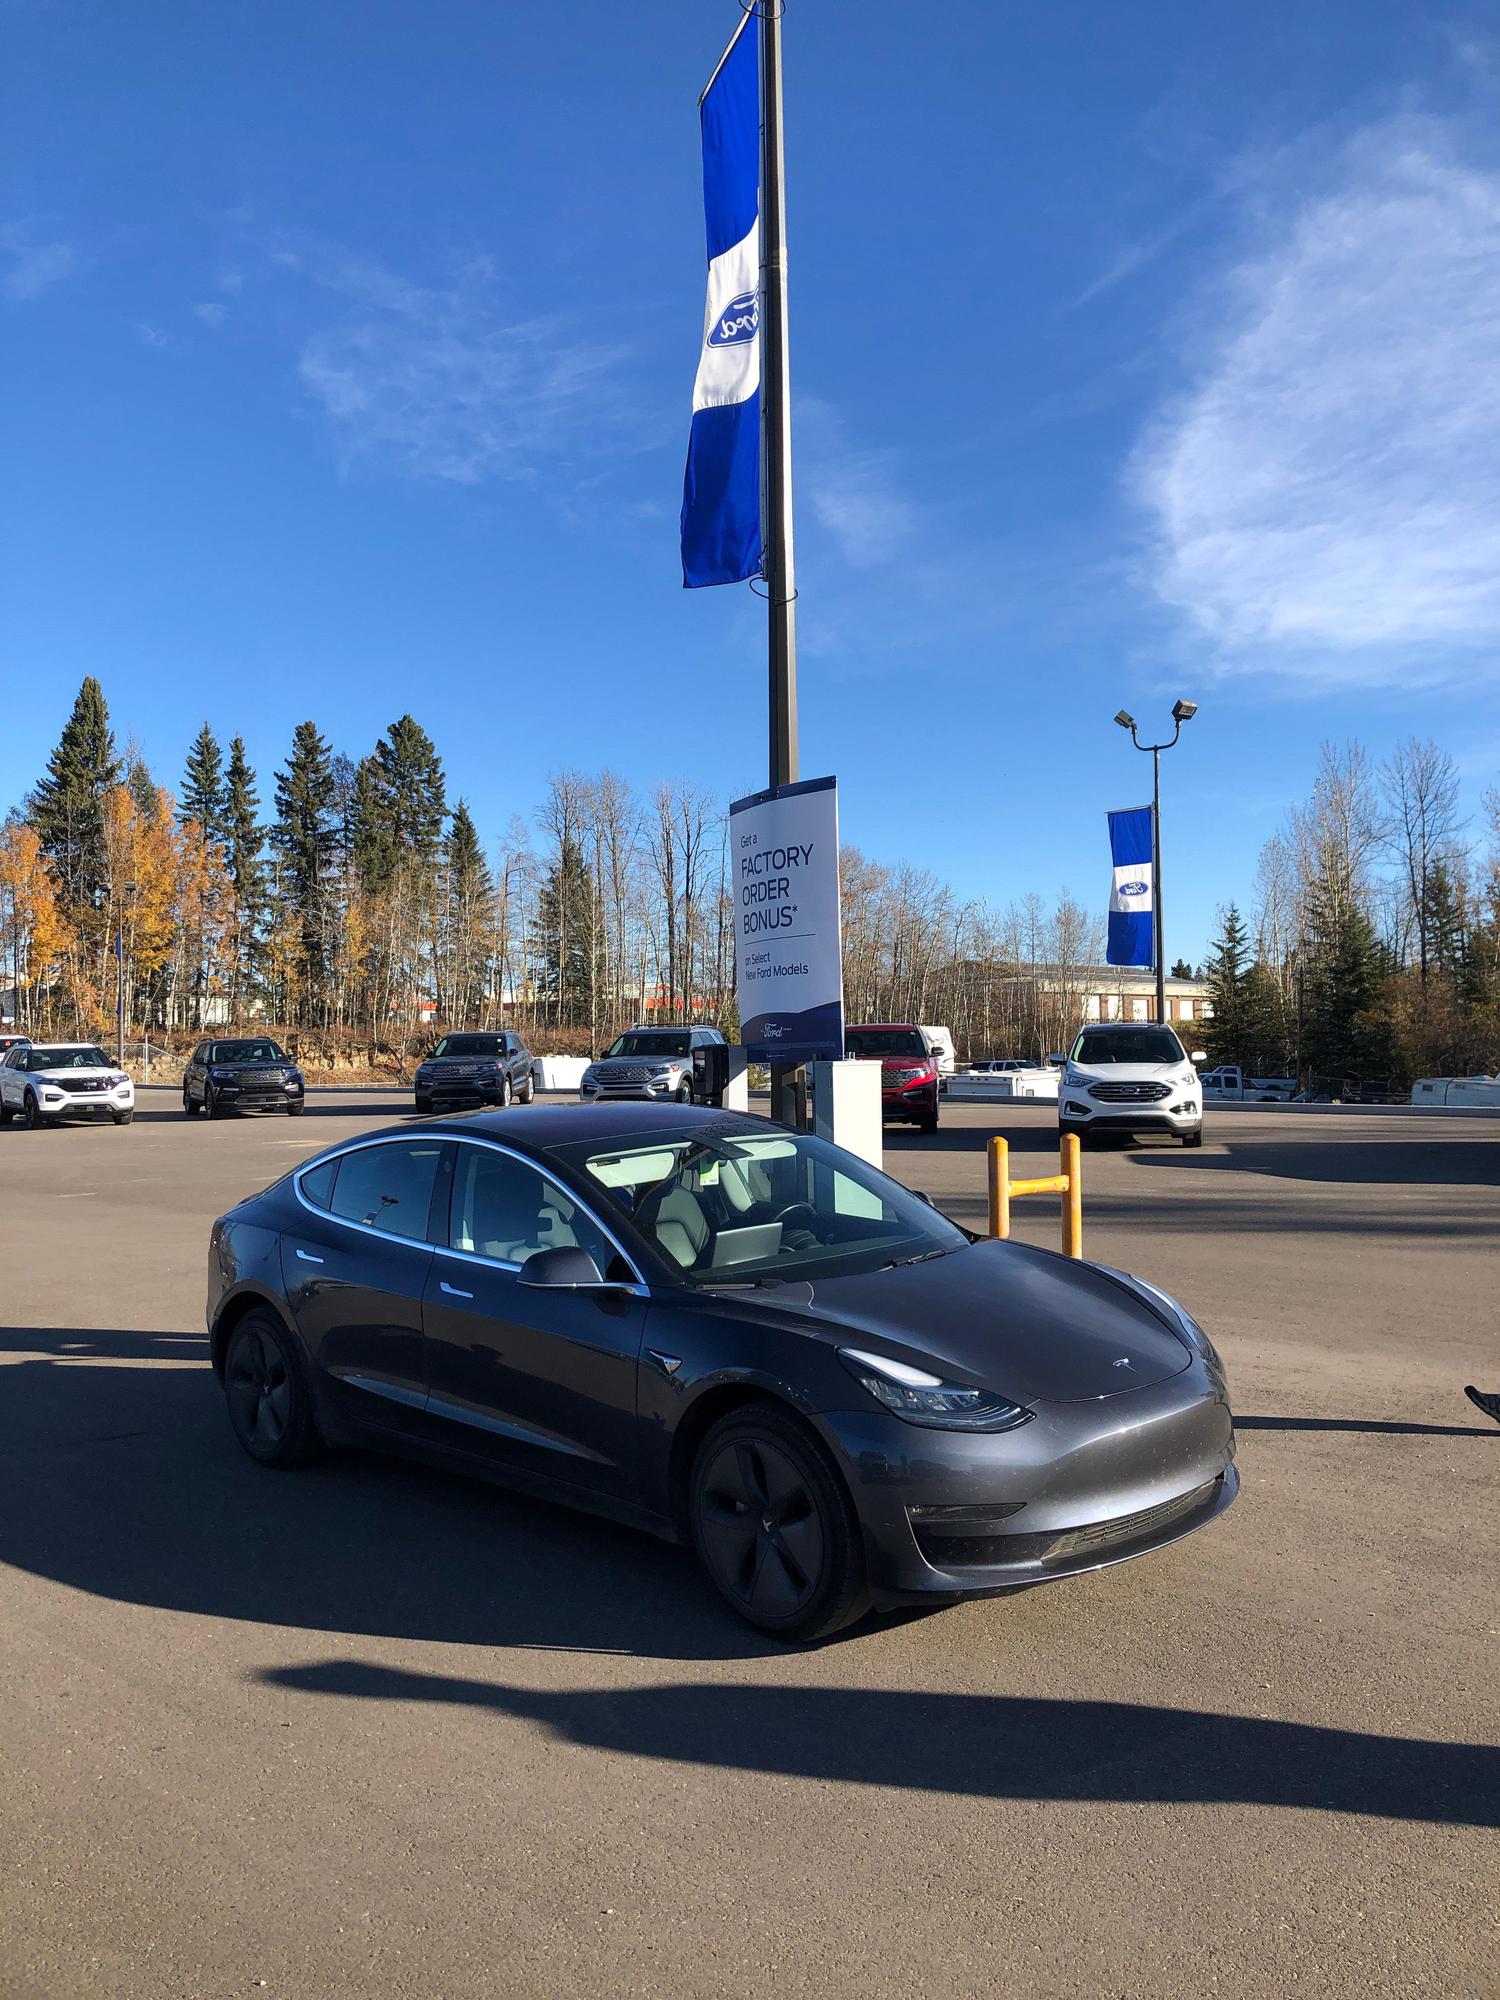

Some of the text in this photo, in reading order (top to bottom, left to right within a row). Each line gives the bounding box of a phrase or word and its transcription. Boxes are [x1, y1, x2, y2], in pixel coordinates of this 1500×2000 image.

[741, 834, 758, 848] Get a
[741, 843, 814, 879] FACTORY
[742, 877, 790, 907] ORDER
[745, 952, 771, 966] on Select
[745, 963, 809, 981] New Ford Models
[763, 1022, 784, 1038] Ford
